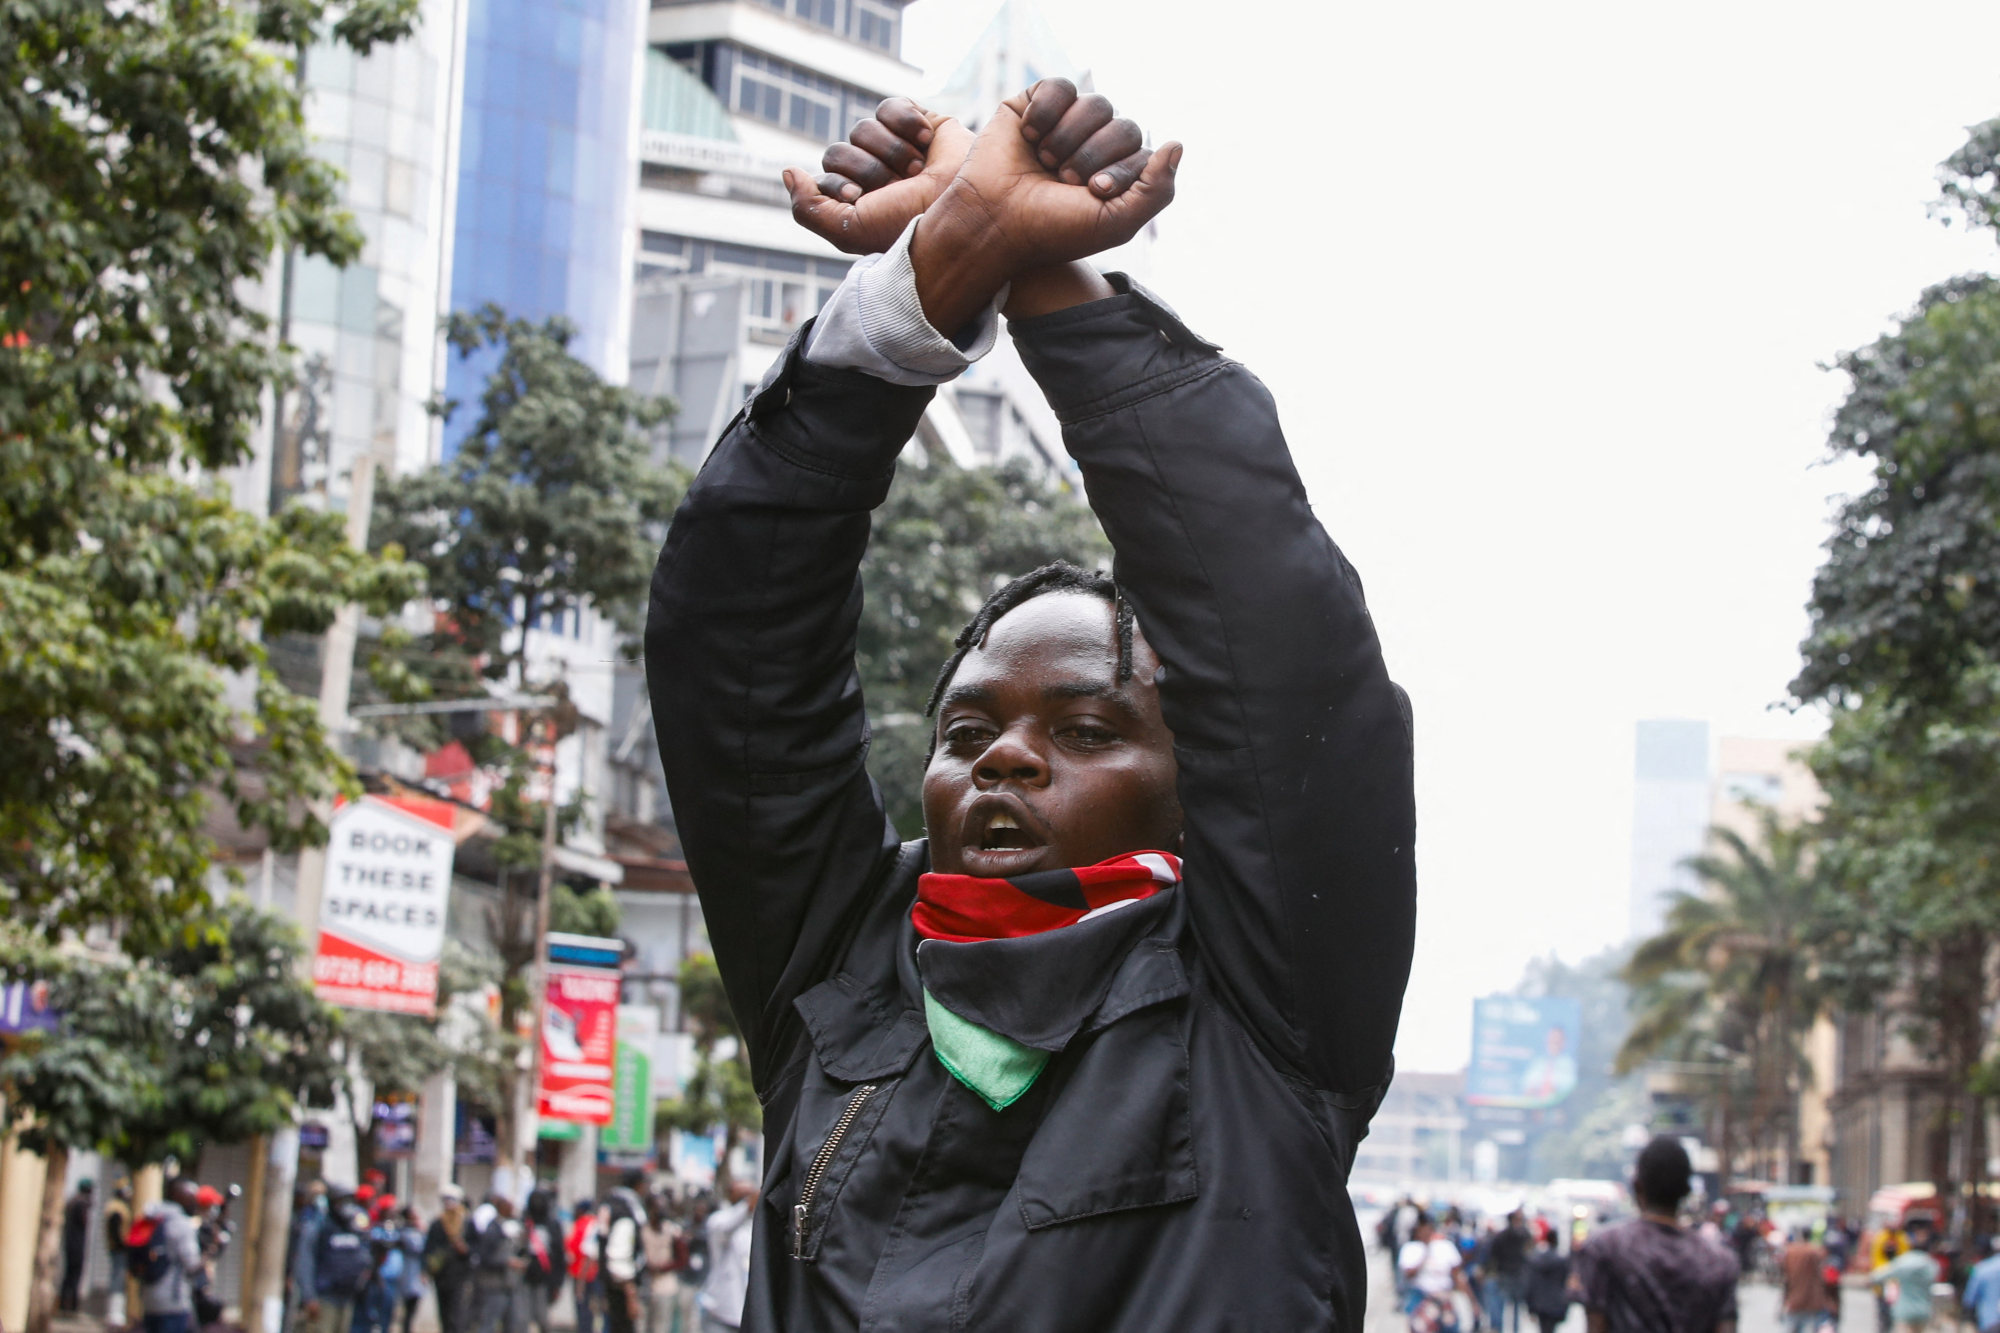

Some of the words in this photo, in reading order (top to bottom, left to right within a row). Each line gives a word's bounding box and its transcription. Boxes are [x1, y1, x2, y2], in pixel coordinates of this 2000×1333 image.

[351, 832, 431, 857] BOOK
[340, 864, 433, 890] THESE
[328, 899, 438, 926] SPACES
